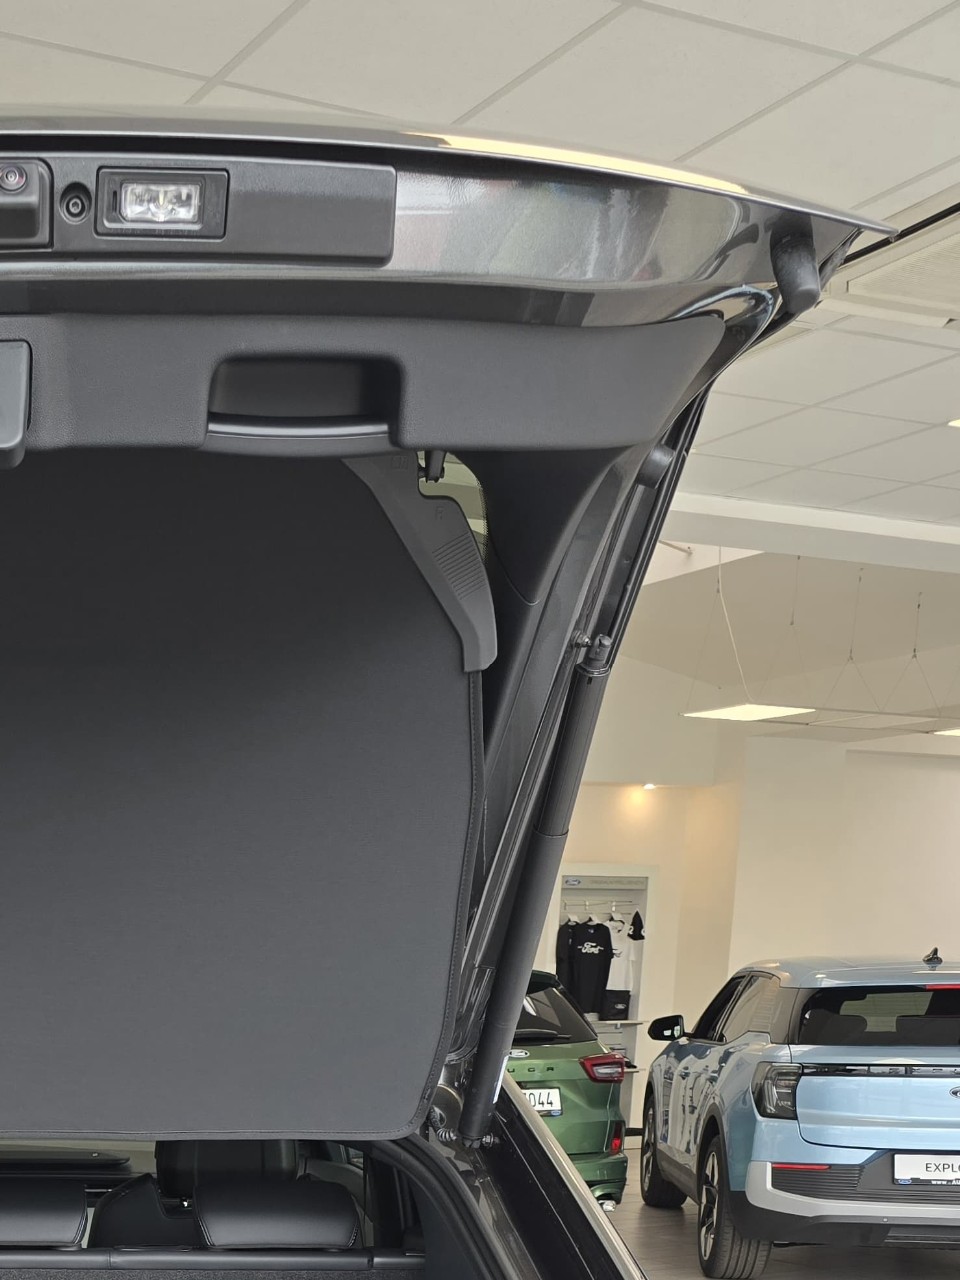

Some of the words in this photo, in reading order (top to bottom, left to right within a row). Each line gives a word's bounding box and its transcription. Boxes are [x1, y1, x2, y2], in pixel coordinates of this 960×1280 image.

[581, 942, 600, 953] Ford
[524, 1092, 553, 1107] 044
[925, 1162, 960, 1173] EXPL
